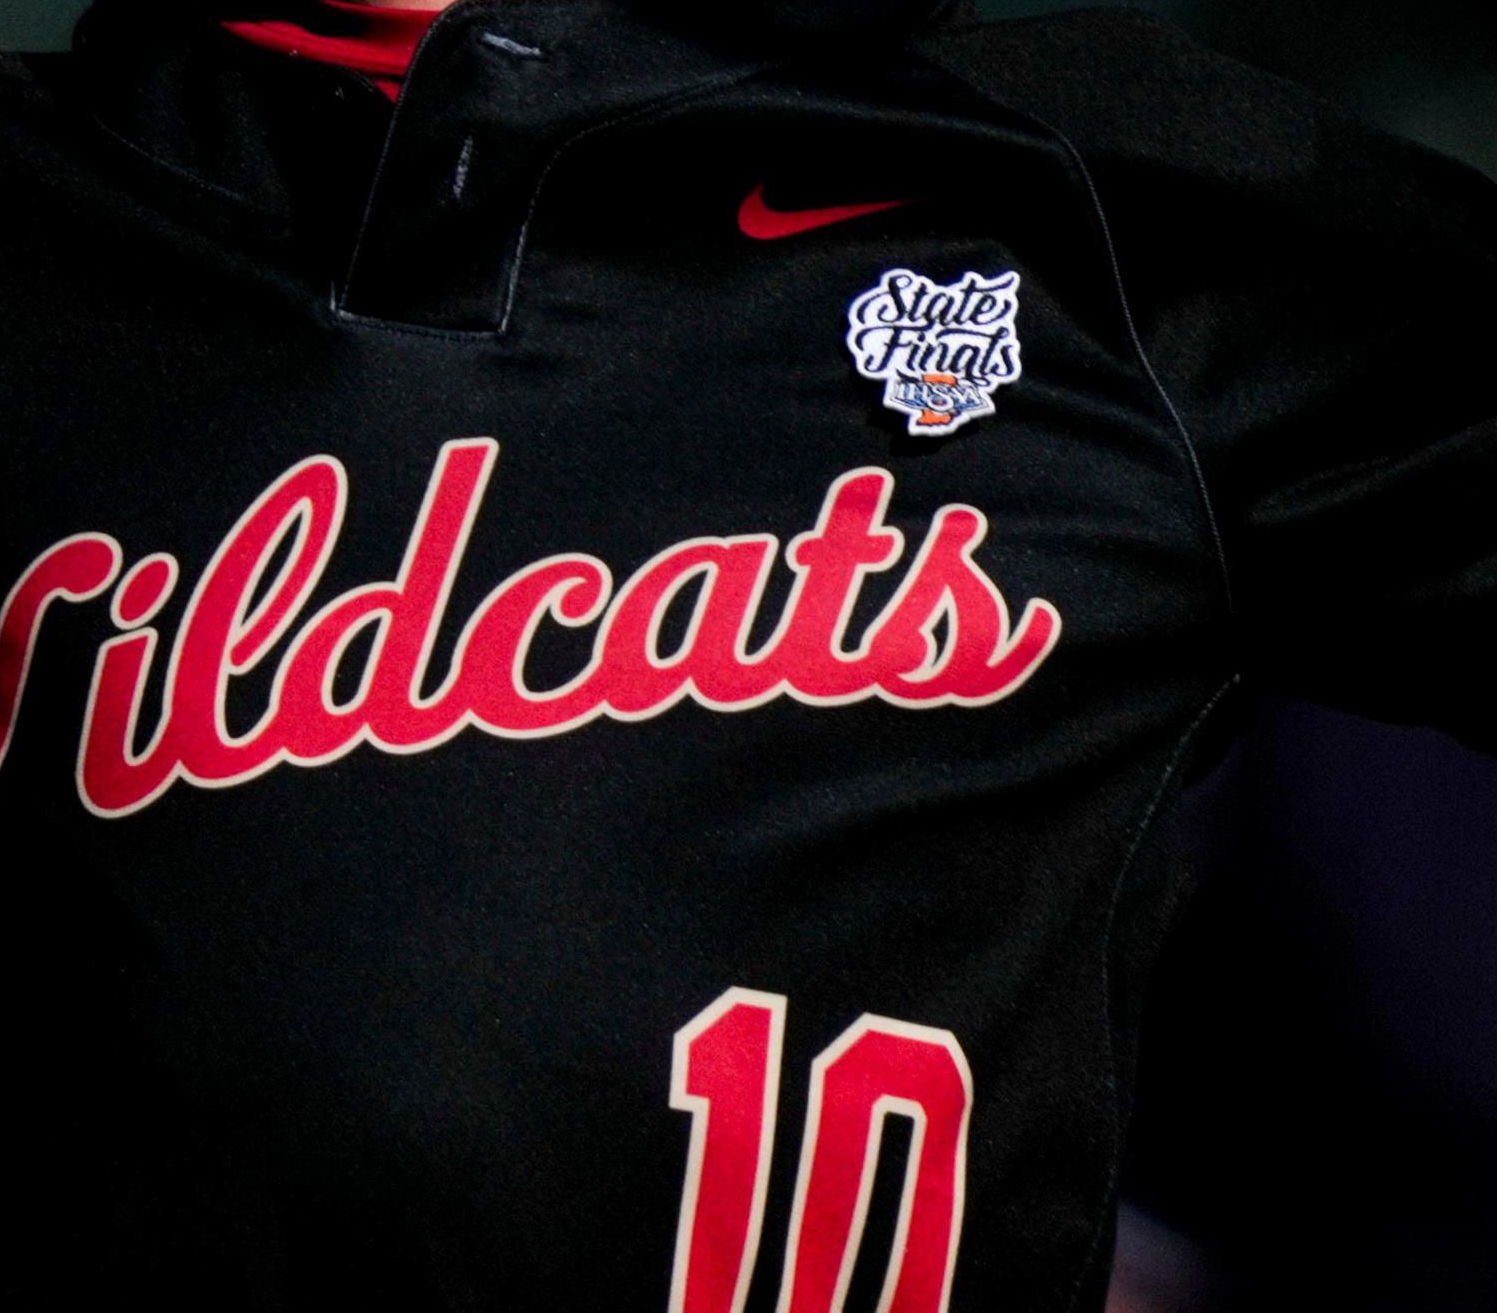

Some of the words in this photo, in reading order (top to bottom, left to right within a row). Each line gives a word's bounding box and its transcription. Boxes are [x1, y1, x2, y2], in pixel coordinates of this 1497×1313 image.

[857, 274, 1015, 326] State
[855, 325, 1015, 386] Finals
[669, 986, 974, 1313] 10
